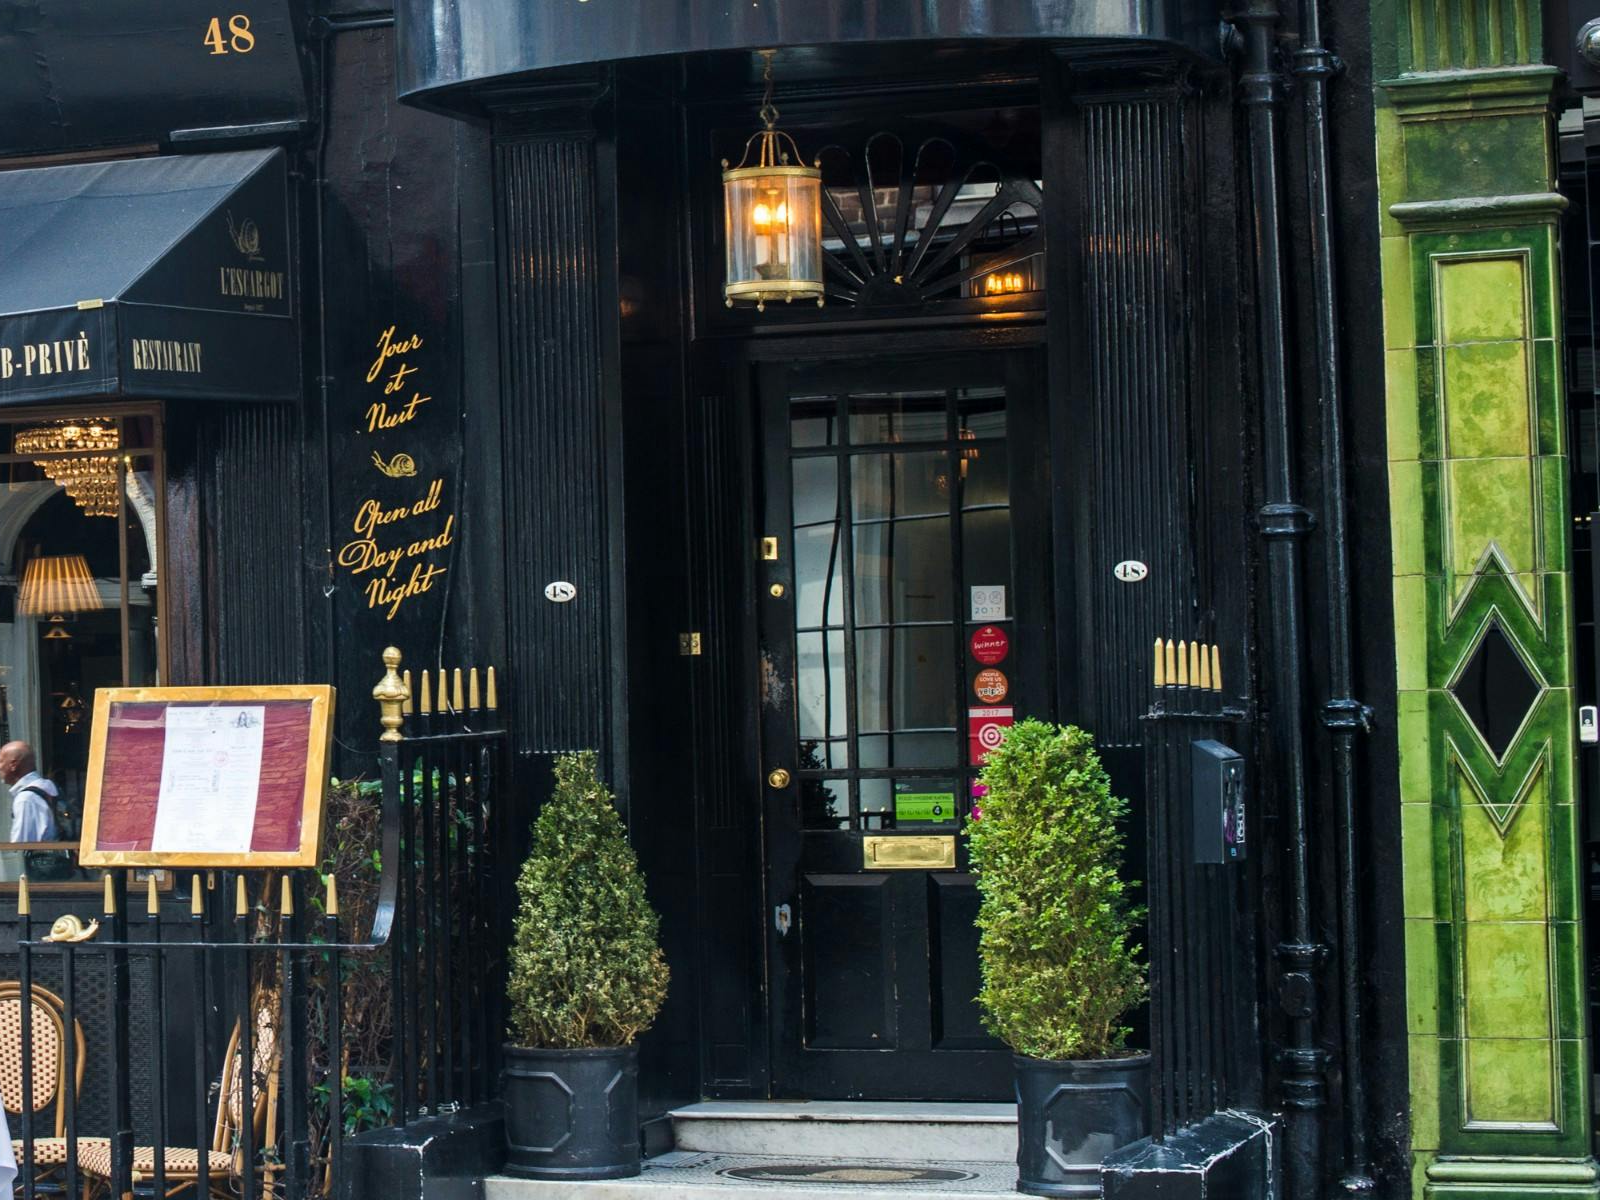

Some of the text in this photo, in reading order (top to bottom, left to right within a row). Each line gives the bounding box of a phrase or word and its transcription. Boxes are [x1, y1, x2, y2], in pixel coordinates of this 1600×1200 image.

[203, 15, 256, 55] 48
[220, 266, 284, 300] L'ESCARGOT
[132, 338, 202, 373] RESTAURANT
[366, 325, 423, 383] Jour
[384, 363, 419, 395] et
[366, 393, 432, 433] Nuit
[353, 479, 443, 539] Open all
[338, 515, 454, 577] Day and
[365, 563, 447, 621] Night
